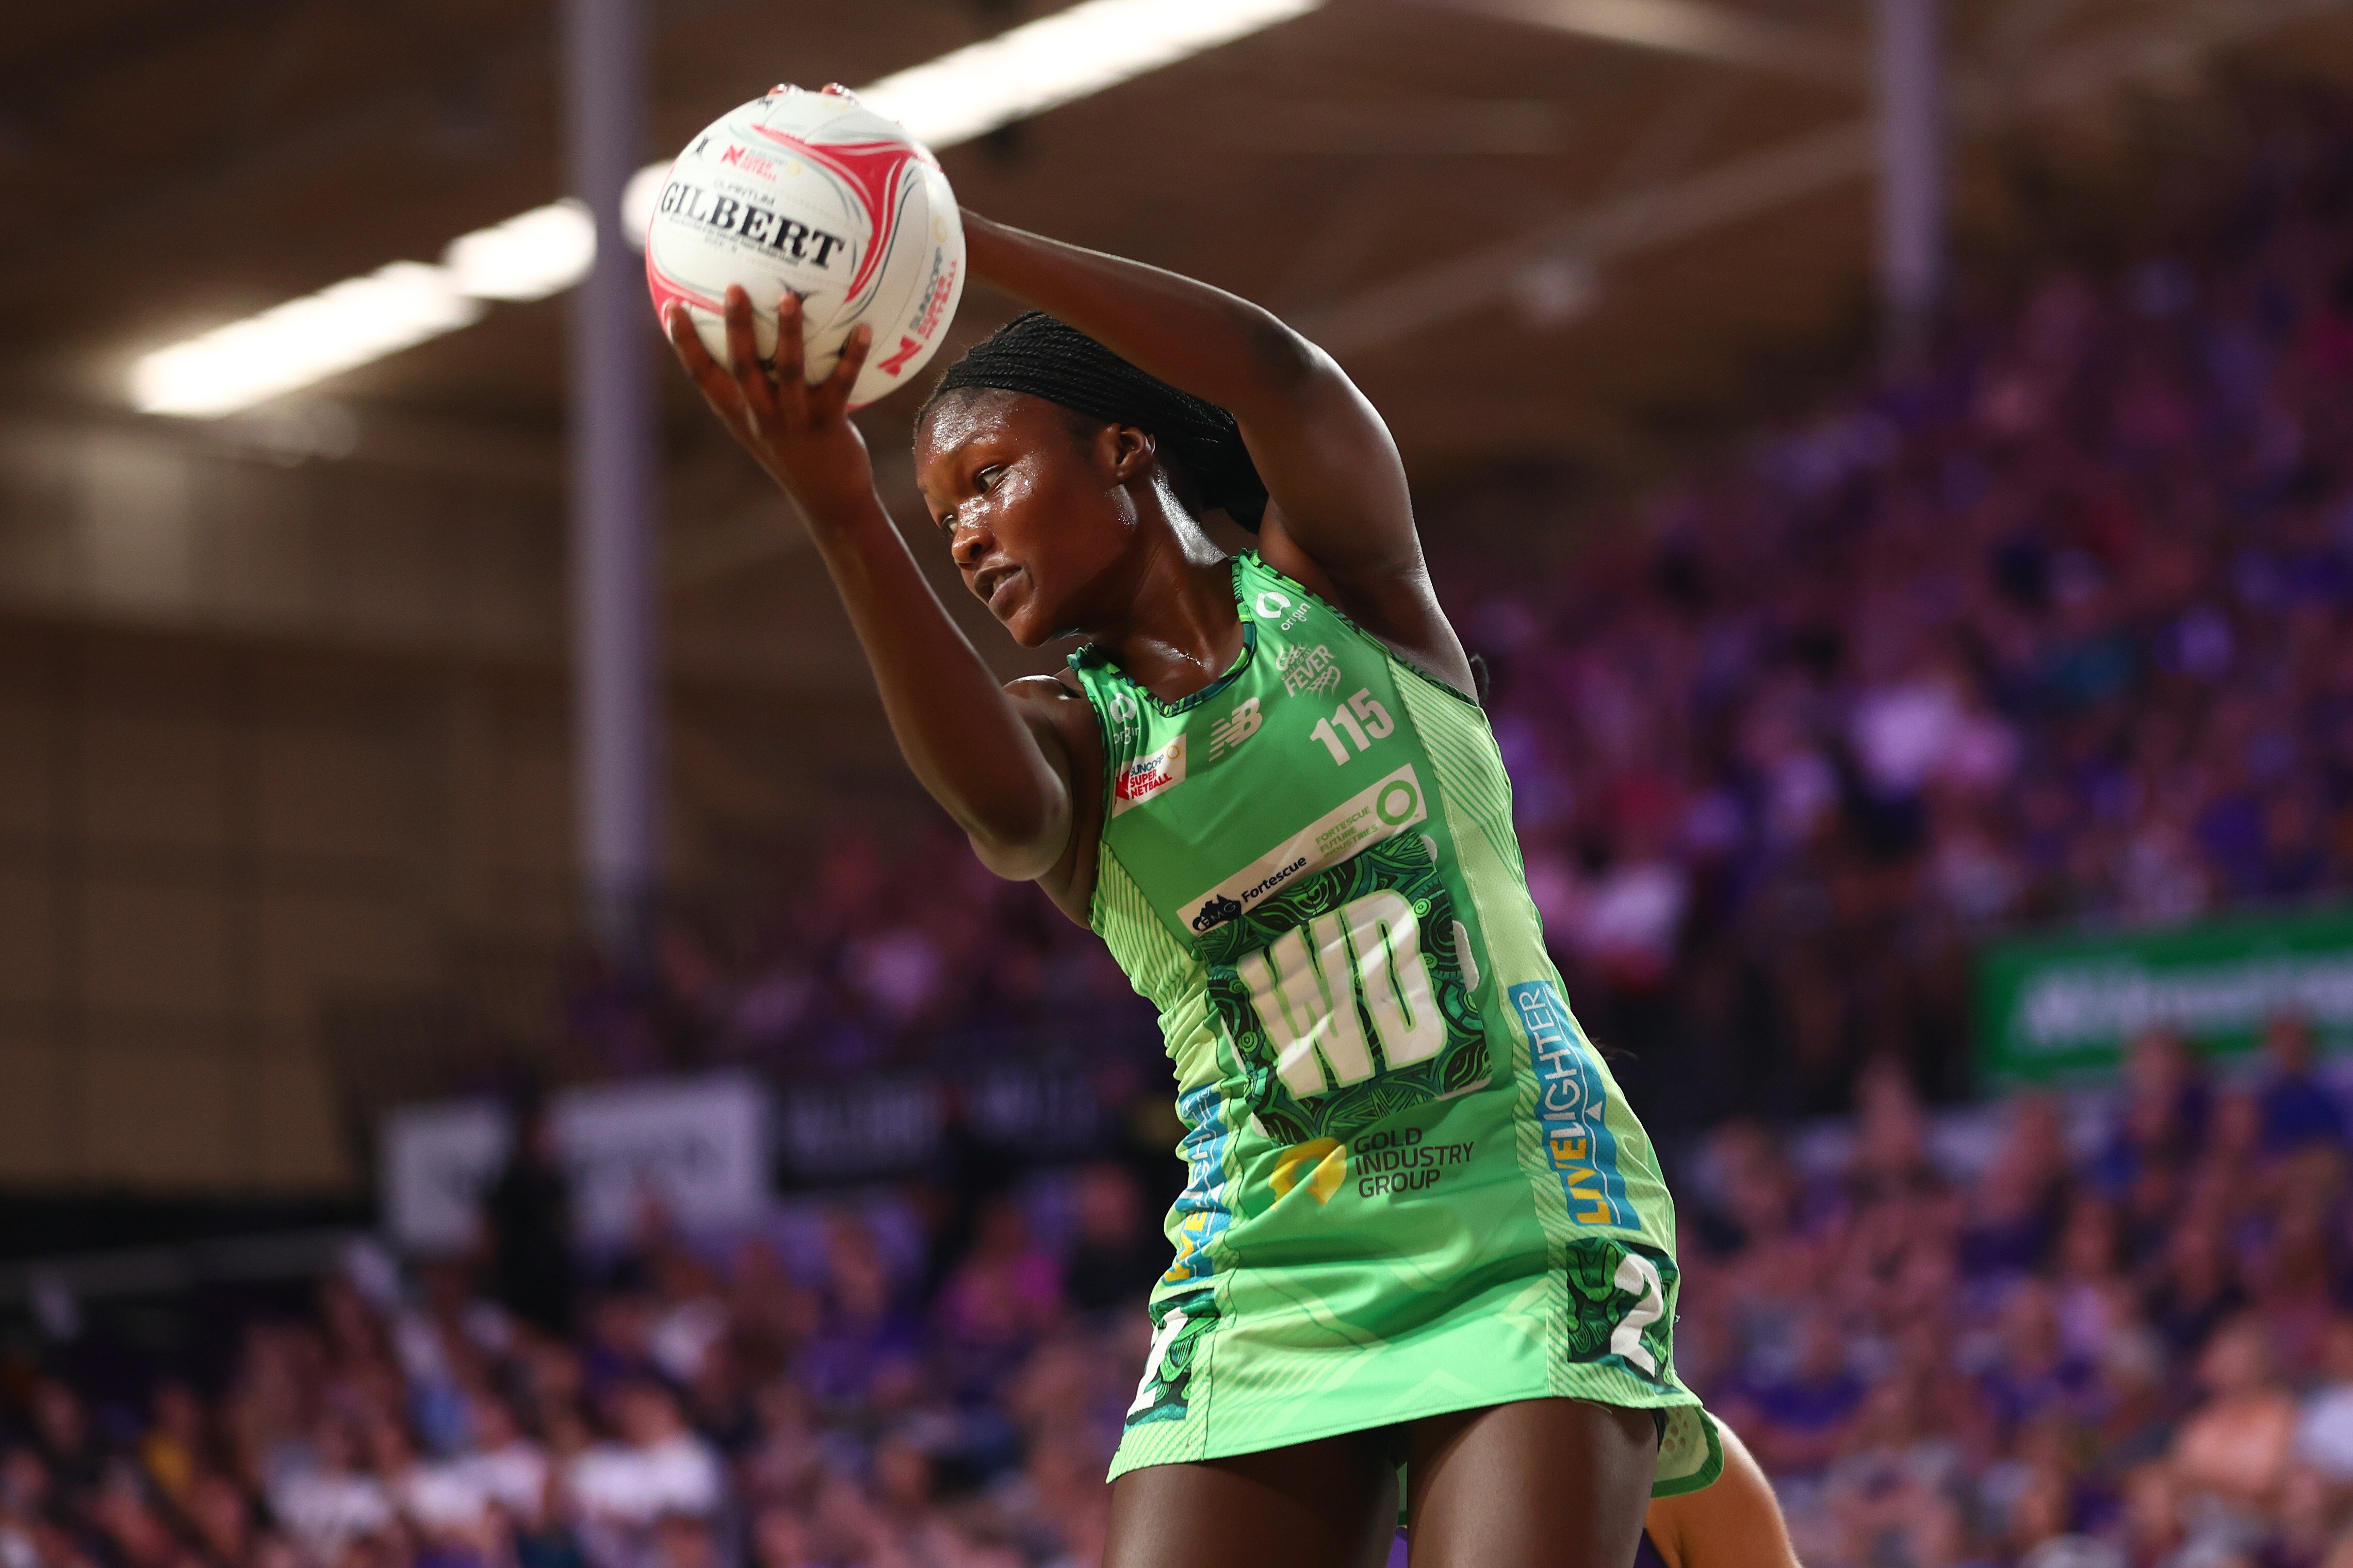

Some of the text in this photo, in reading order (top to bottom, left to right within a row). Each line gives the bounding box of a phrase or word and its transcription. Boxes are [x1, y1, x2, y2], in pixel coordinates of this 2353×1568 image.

[661, 180, 846, 270] GILBERT
[1281, 602, 1312, 631] origin
[1284, 645, 1335, 698] FEVER
[1310, 687, 1395, 766] 115
[1130, 769, 1157, 788] SUPER
[1131, 772, 1173, 800] NETBALL
[1241, 857, 1307, 903] Fortescue
[1238, 889, 1448, 1100] WD
[1518, 987, 1612, 1225] LIVELIGHTER
[1354, 1127, 1423, 1155] GOLD
[1355, 1142, 1475, 1176] INDUSTRY
[1359, 1169, 1441, 1198] GROUP
[1611, 1253, 1663, 1378] 2
